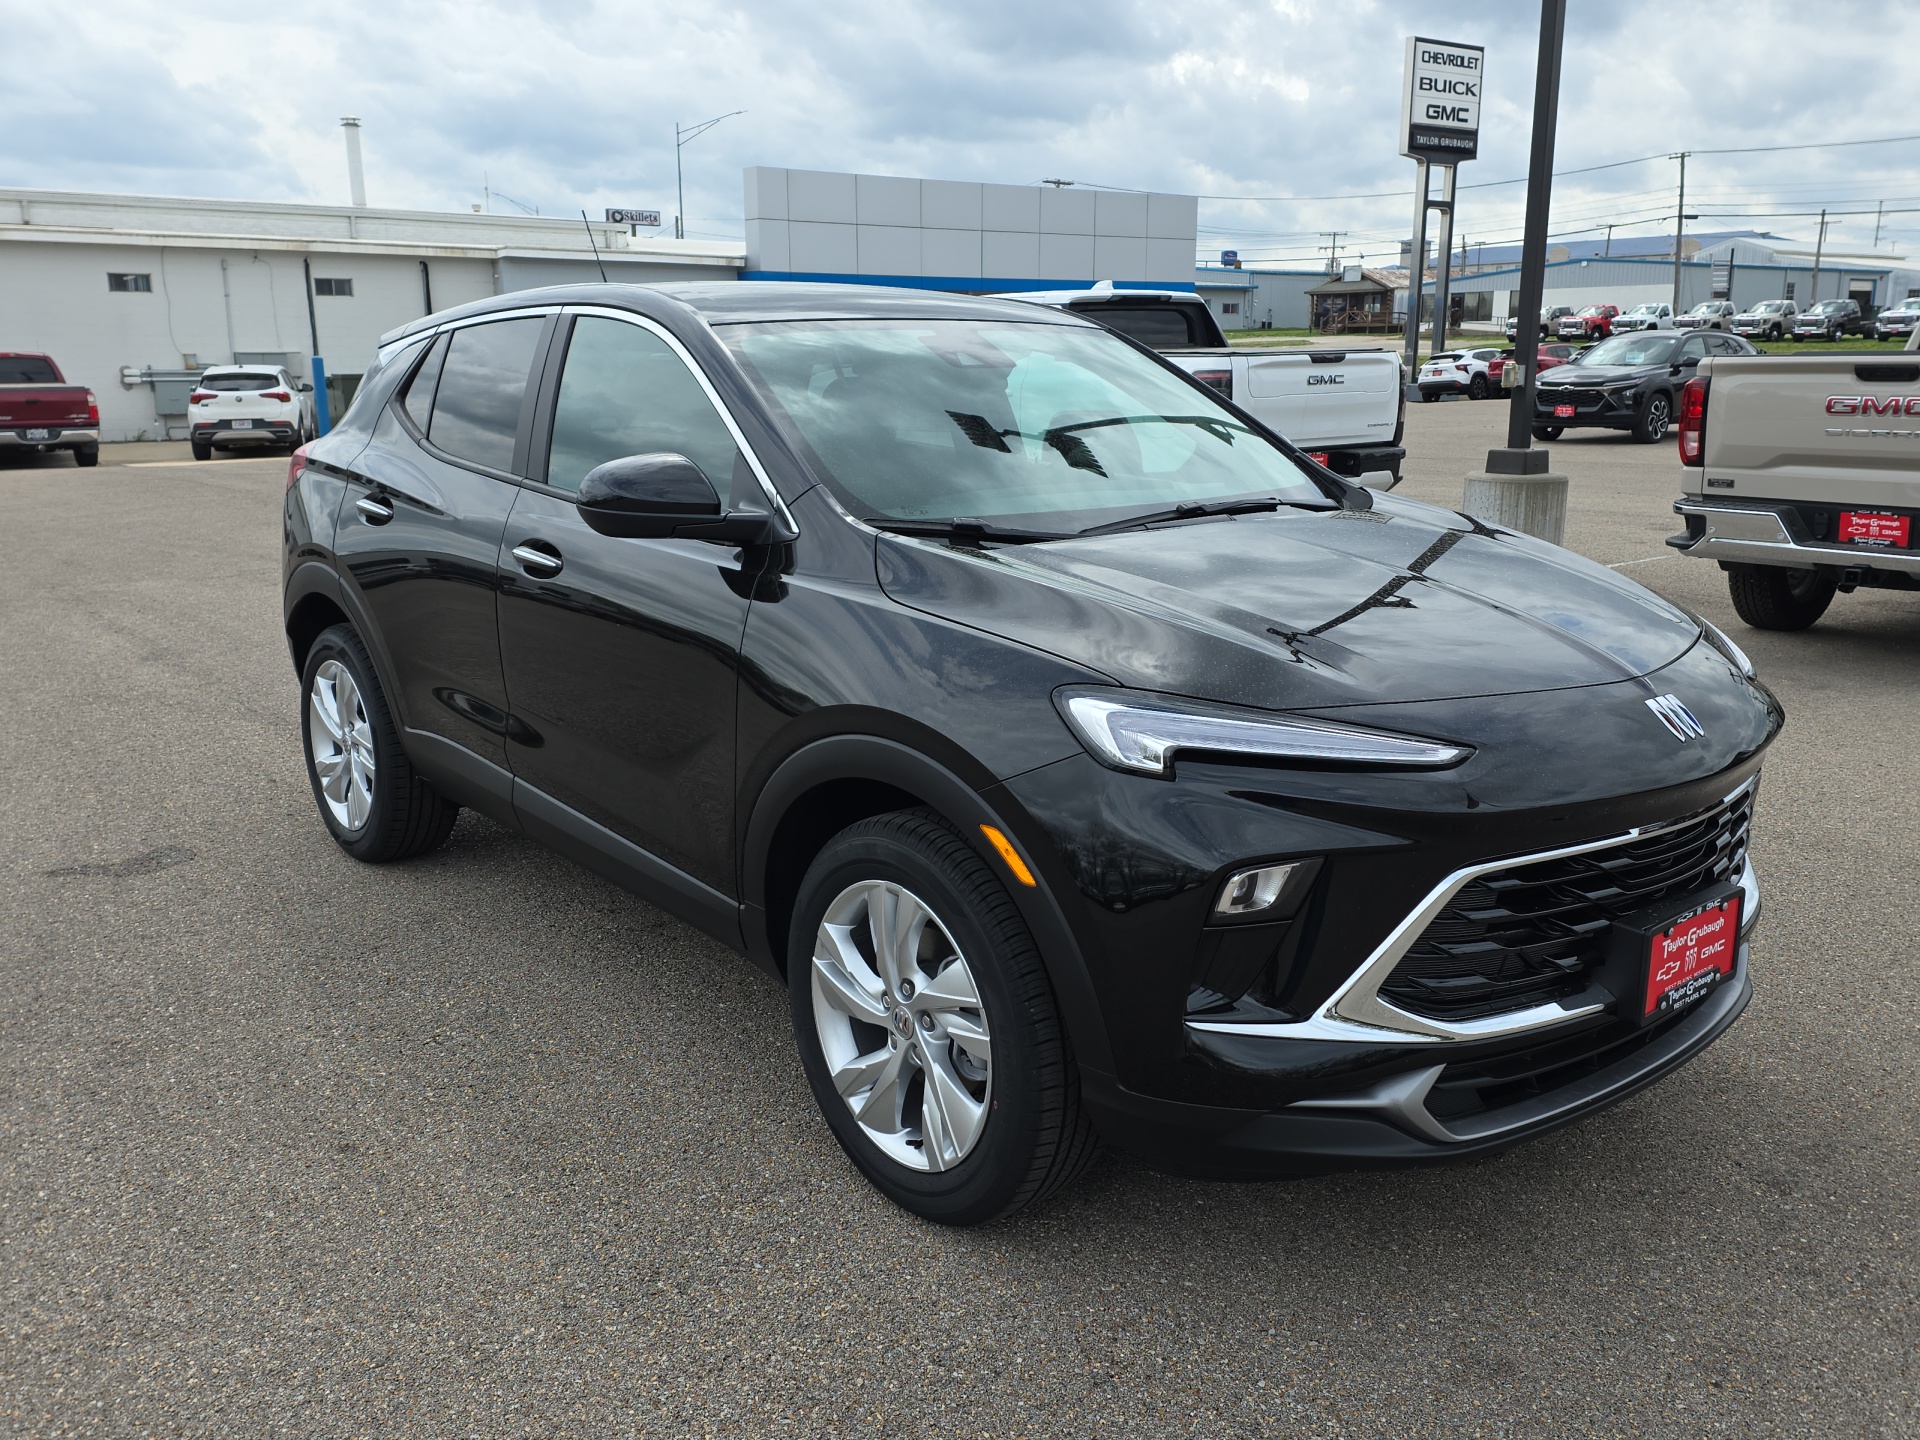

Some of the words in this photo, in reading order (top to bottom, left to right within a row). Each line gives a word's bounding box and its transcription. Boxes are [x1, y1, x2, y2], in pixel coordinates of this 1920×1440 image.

[1422, 50, 1479, 70] CHEVROLET
[1419, 76, 1478, 97] BUICK
[1426, 104, 1469, 123] GMC
[1416, 135, 1439, 145] TAYLOR
[1440, 137, 1474, 149] GRUBAUGH
[624, 211, 658, 222] Skillets
[1307, 374, 1345, 385] GMC
[1851, 517, 1870, 525] Taylor
[1870, 518, 1900, 527] Grubaugh
[1706, 898, 1721, 911] GMC
[1662, 935, 1687, 959] Taylor
[1687, 916, 1725, 946] Grubaugh
[1700, 939, 1726, 959] GMC
[1668, 986, 1687, 1005] Taylor
[1686, 971, 1714, 995] Grubaugh
[1673, 999, 1685, 1010] WEST
[1700, 987, 1707, 996] MO
